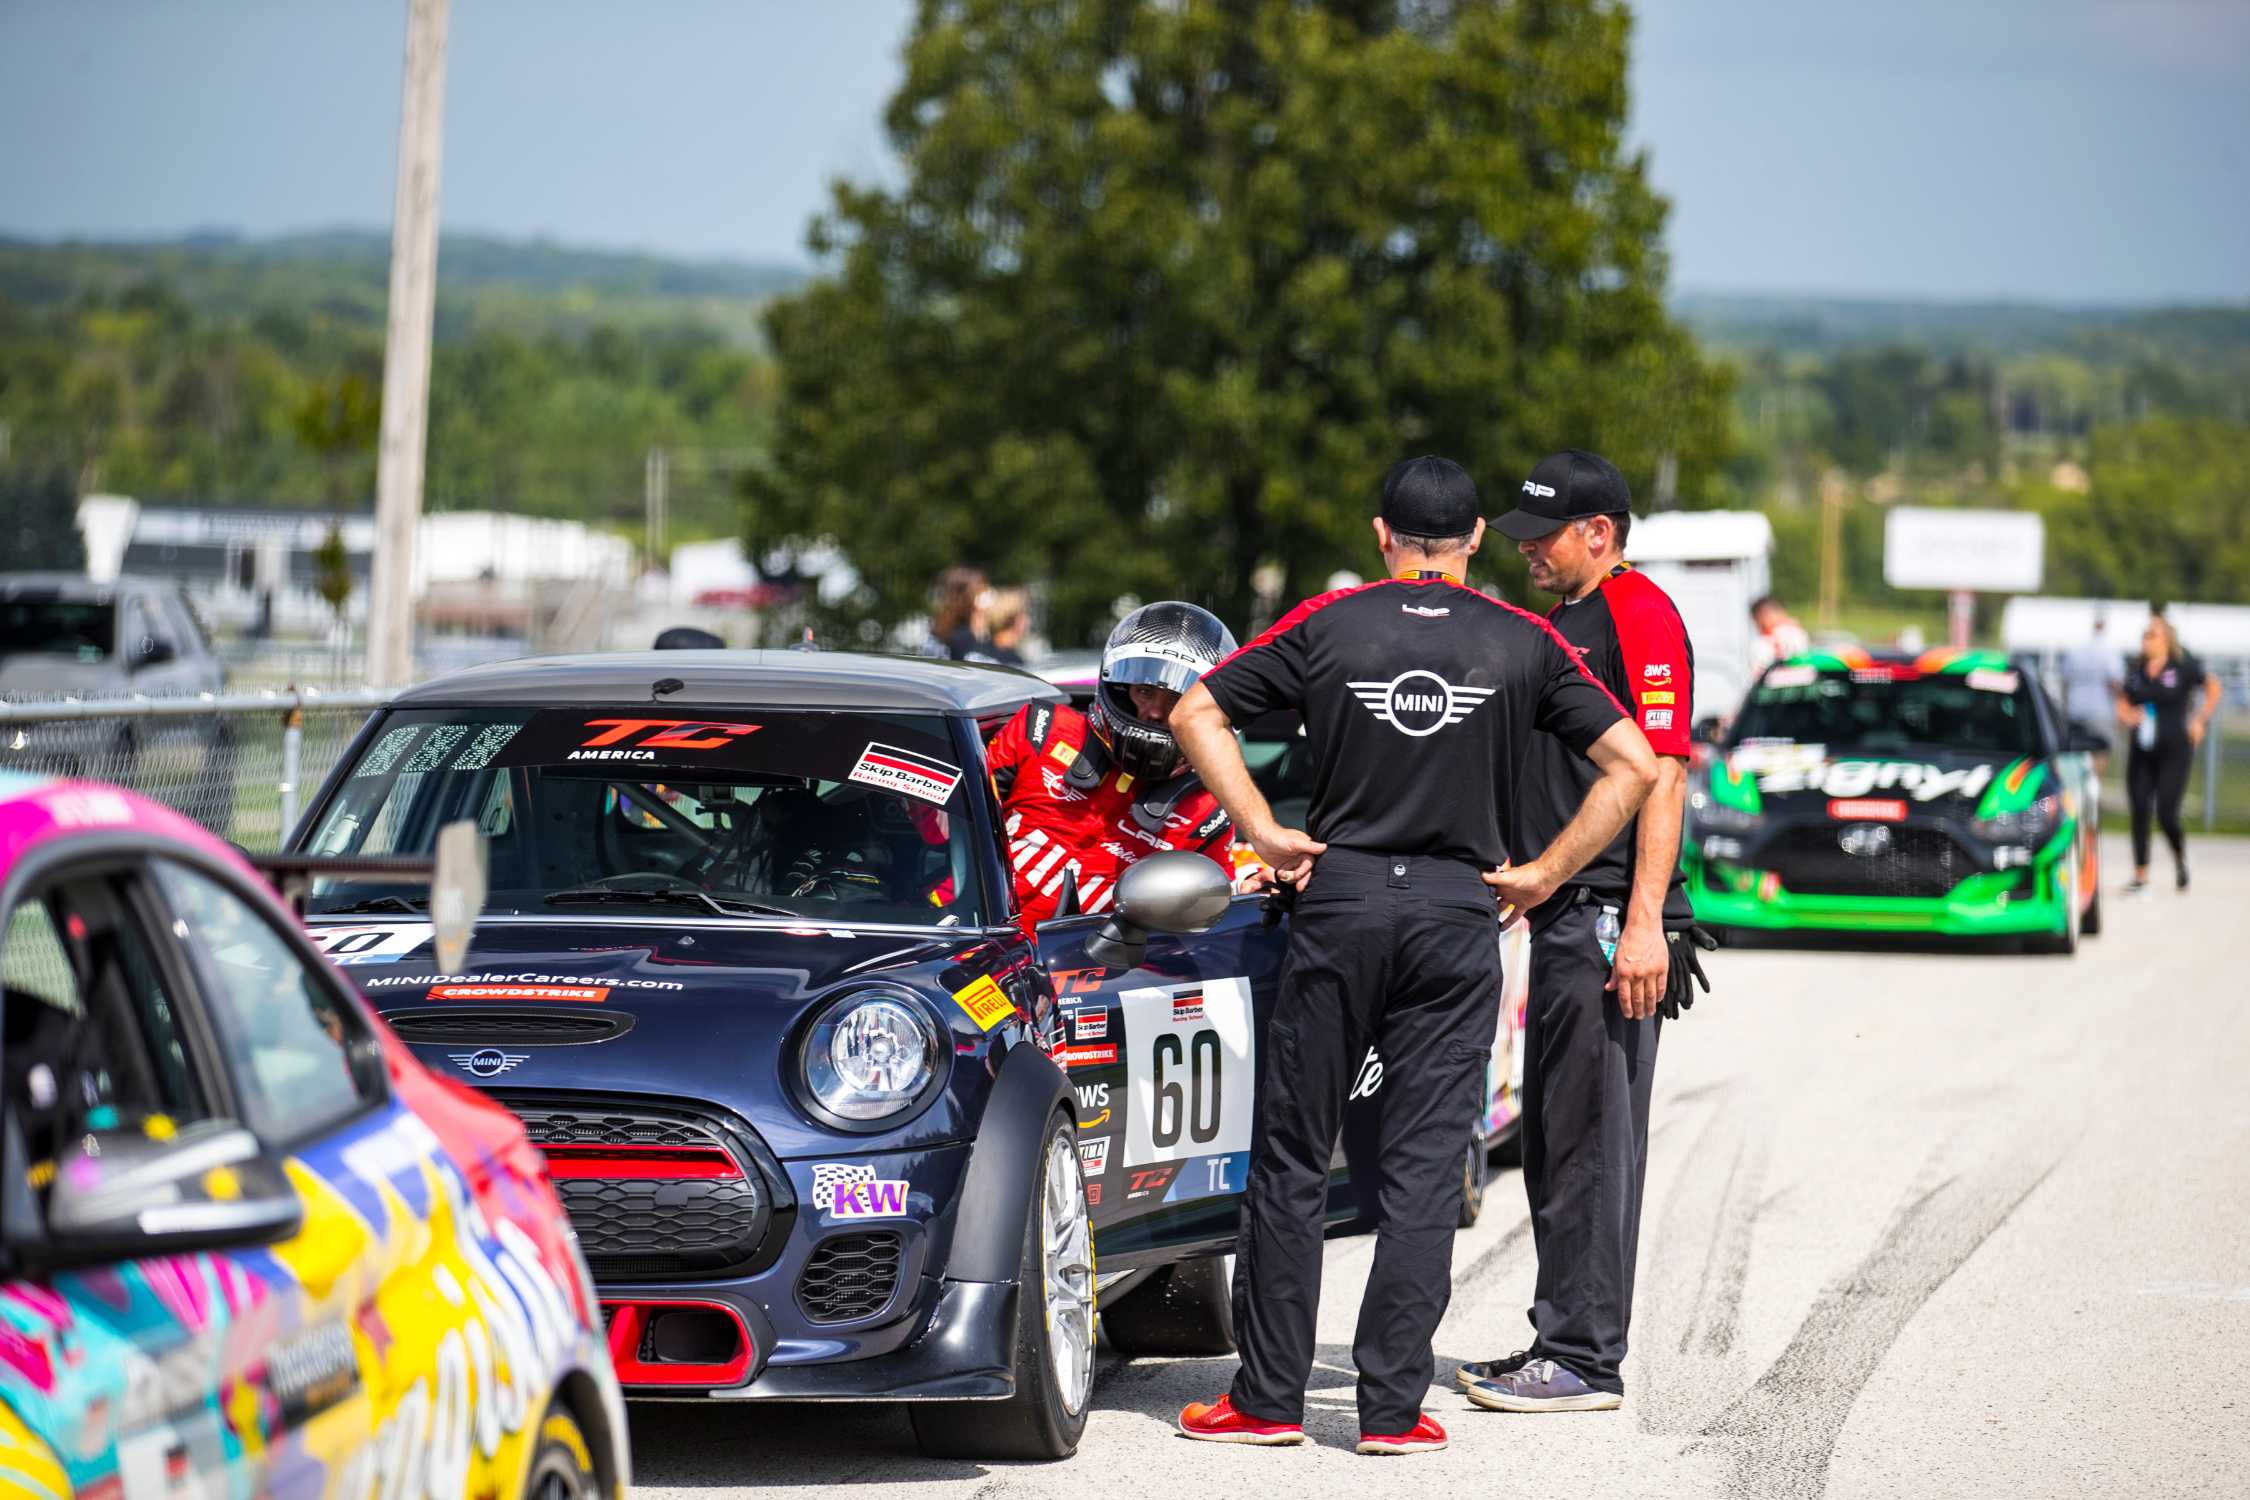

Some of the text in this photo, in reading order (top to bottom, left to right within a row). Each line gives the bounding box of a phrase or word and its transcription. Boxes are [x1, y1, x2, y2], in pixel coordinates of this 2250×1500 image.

[1522, 480, 1556, 498] AP
[1643, 664, 1672, 677] aws
[1394, 693, 1444, 712] MINI
[580, 719, 763, 749] TC
[567, 750, 655, 760] AMERICA
[858, 763, 950, 794] Skip Barber
[367, 972, 684, 992] MINIDealerCareers.com
[1050, 967, 1107, 993] TC
[442, 987, 598, 999] CROWDSTRIKE
[963, 984, 1007, 1020] PIRELLI
[473, 1057, 503, 1068] MINI
[1066, 1049, 1114, 1061] ROWDSTRIKE
[1153, 1029, 1221, 1148] 60
[1207, 1158, 1232, 1192] TC
[834, 1183, 908, 1214] KW
